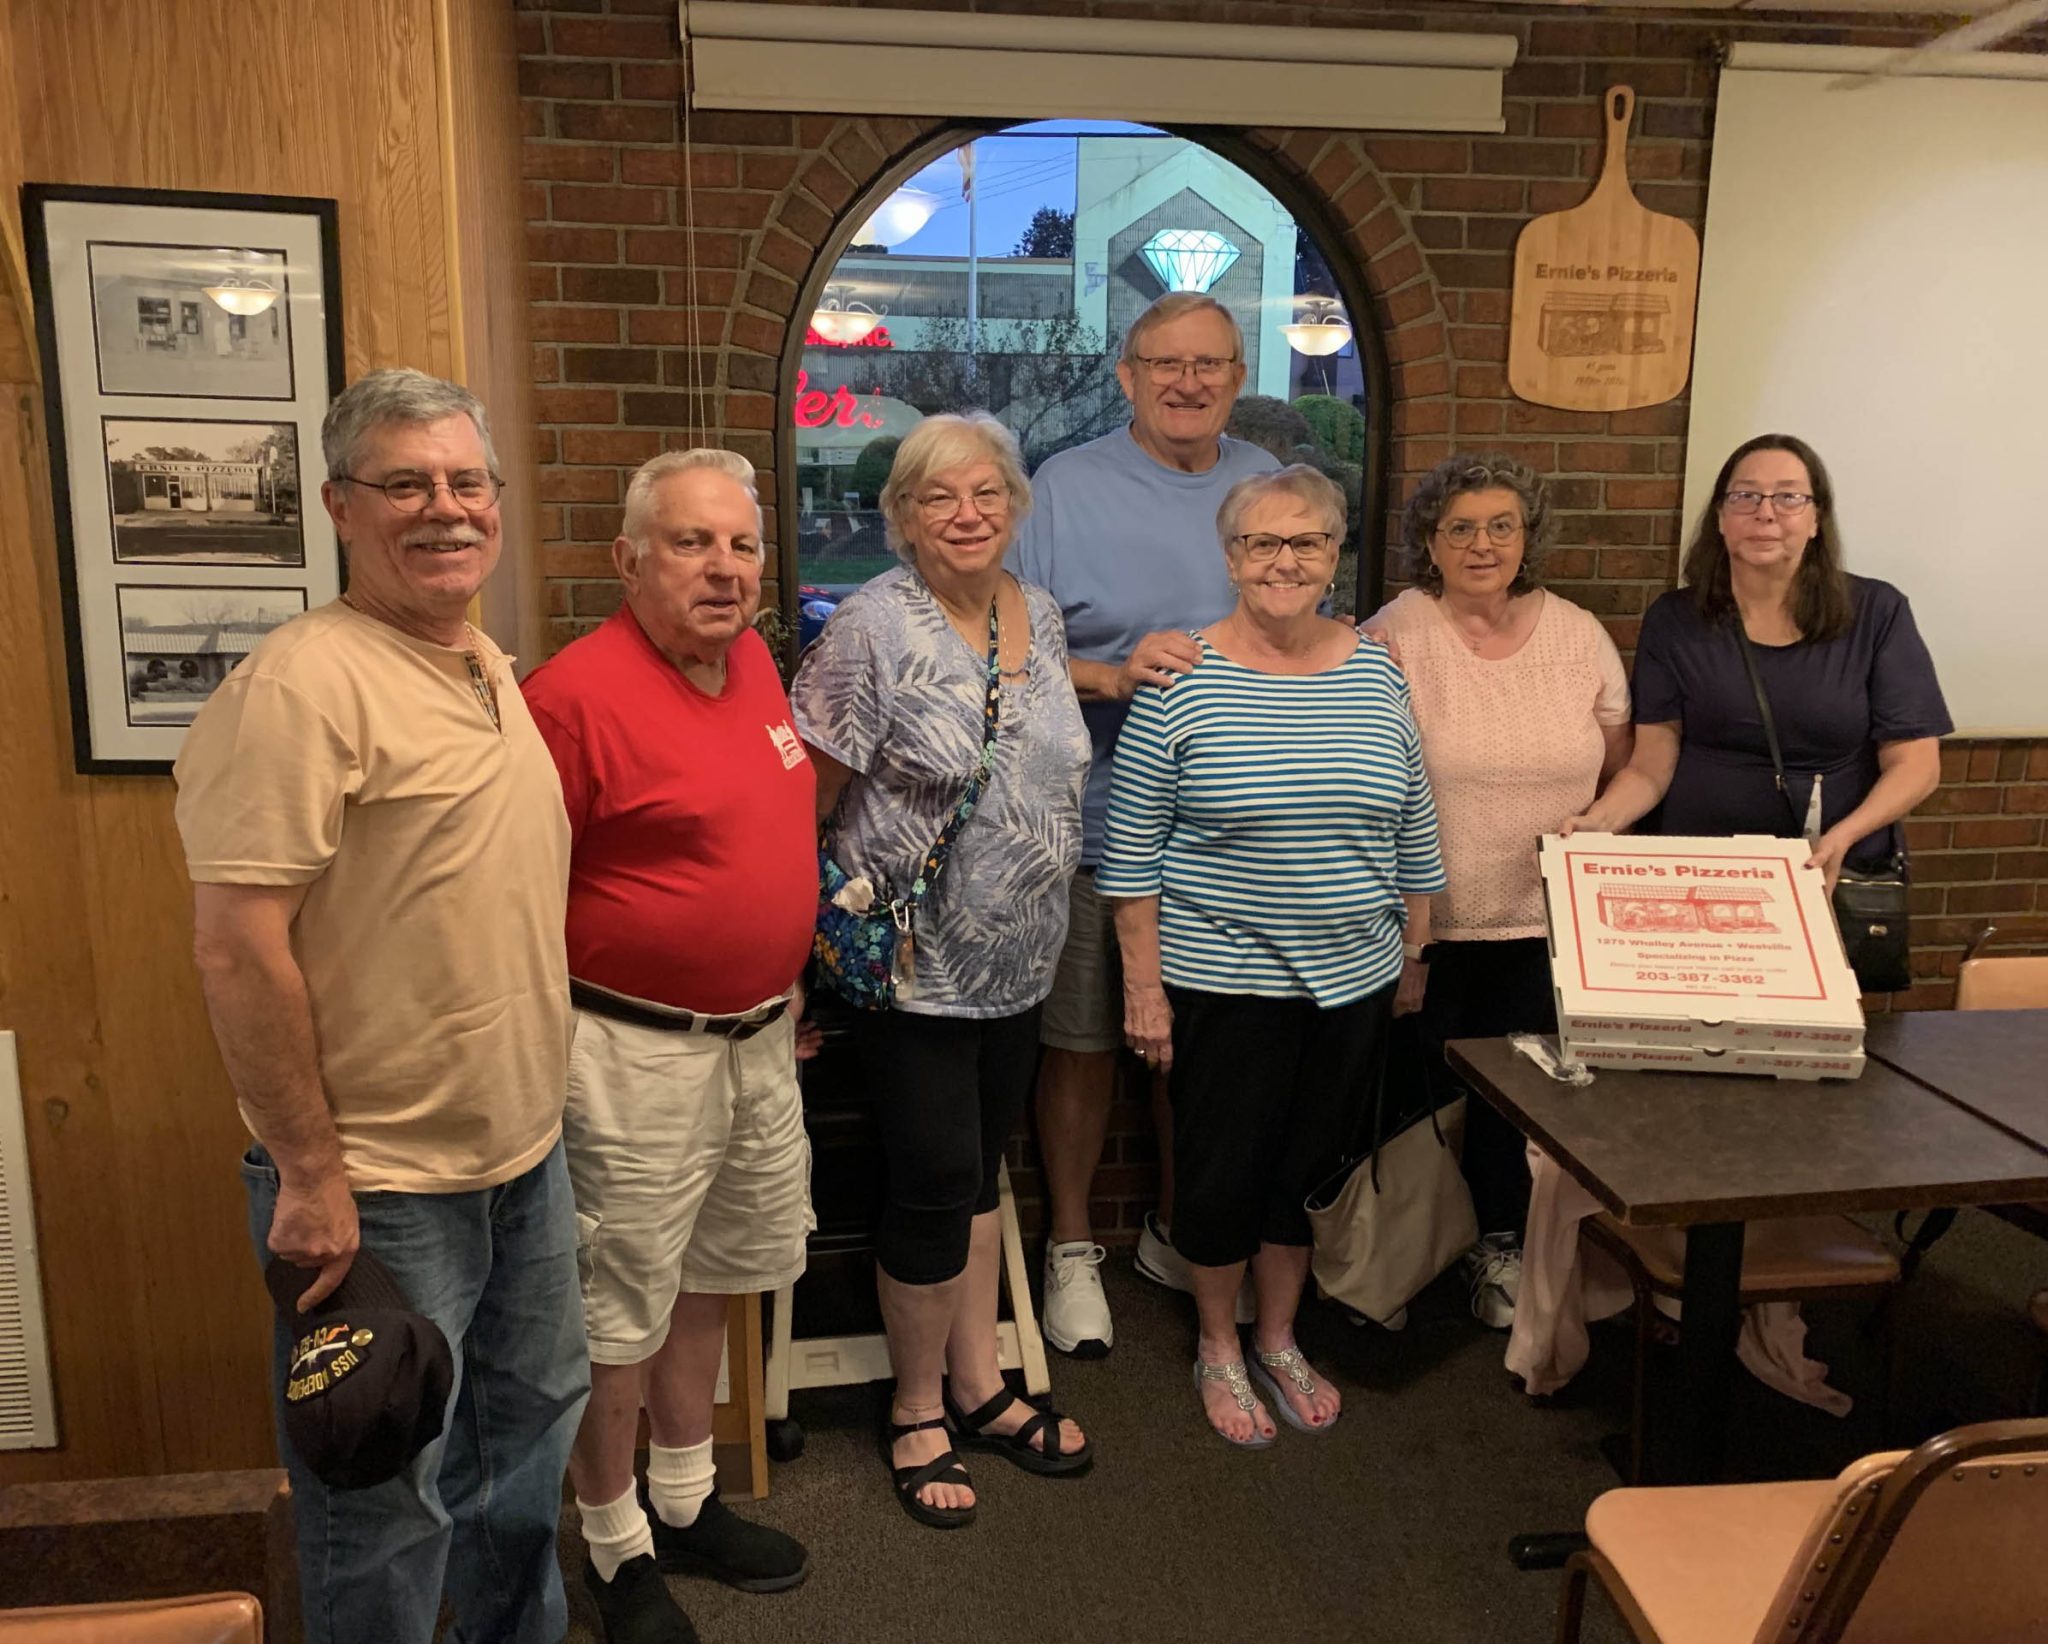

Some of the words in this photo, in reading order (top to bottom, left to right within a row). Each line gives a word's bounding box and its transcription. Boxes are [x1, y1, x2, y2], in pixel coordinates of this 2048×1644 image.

[1535, 263, 1600, 280] Ernie's
[1606, 265, 1678, 283] Pizzeria
[1583, 862, 1666, 877] Ernie's
[1674, 865, 1775, 880] Pizzeria
[1629, 939, 1675, 948] Whalley
[1637, 952, 1706, 962] Specializing
[1723, 954, 1755, 962] Pizza
[1636, 971, 1765, 985] 203-387-3362
[1571, 1019, 1624, 1030] Ernie's
[1629, 1022, 1692, 1033] Pizzeria
[1734, 1028, 1853, 1042] 2-387-3362
[1575, 1050, 1627, 1059] Ernie's
[1632, 1052, 1693, 1062] Pizzeria
[331, 1349, 359, 1377] USS
